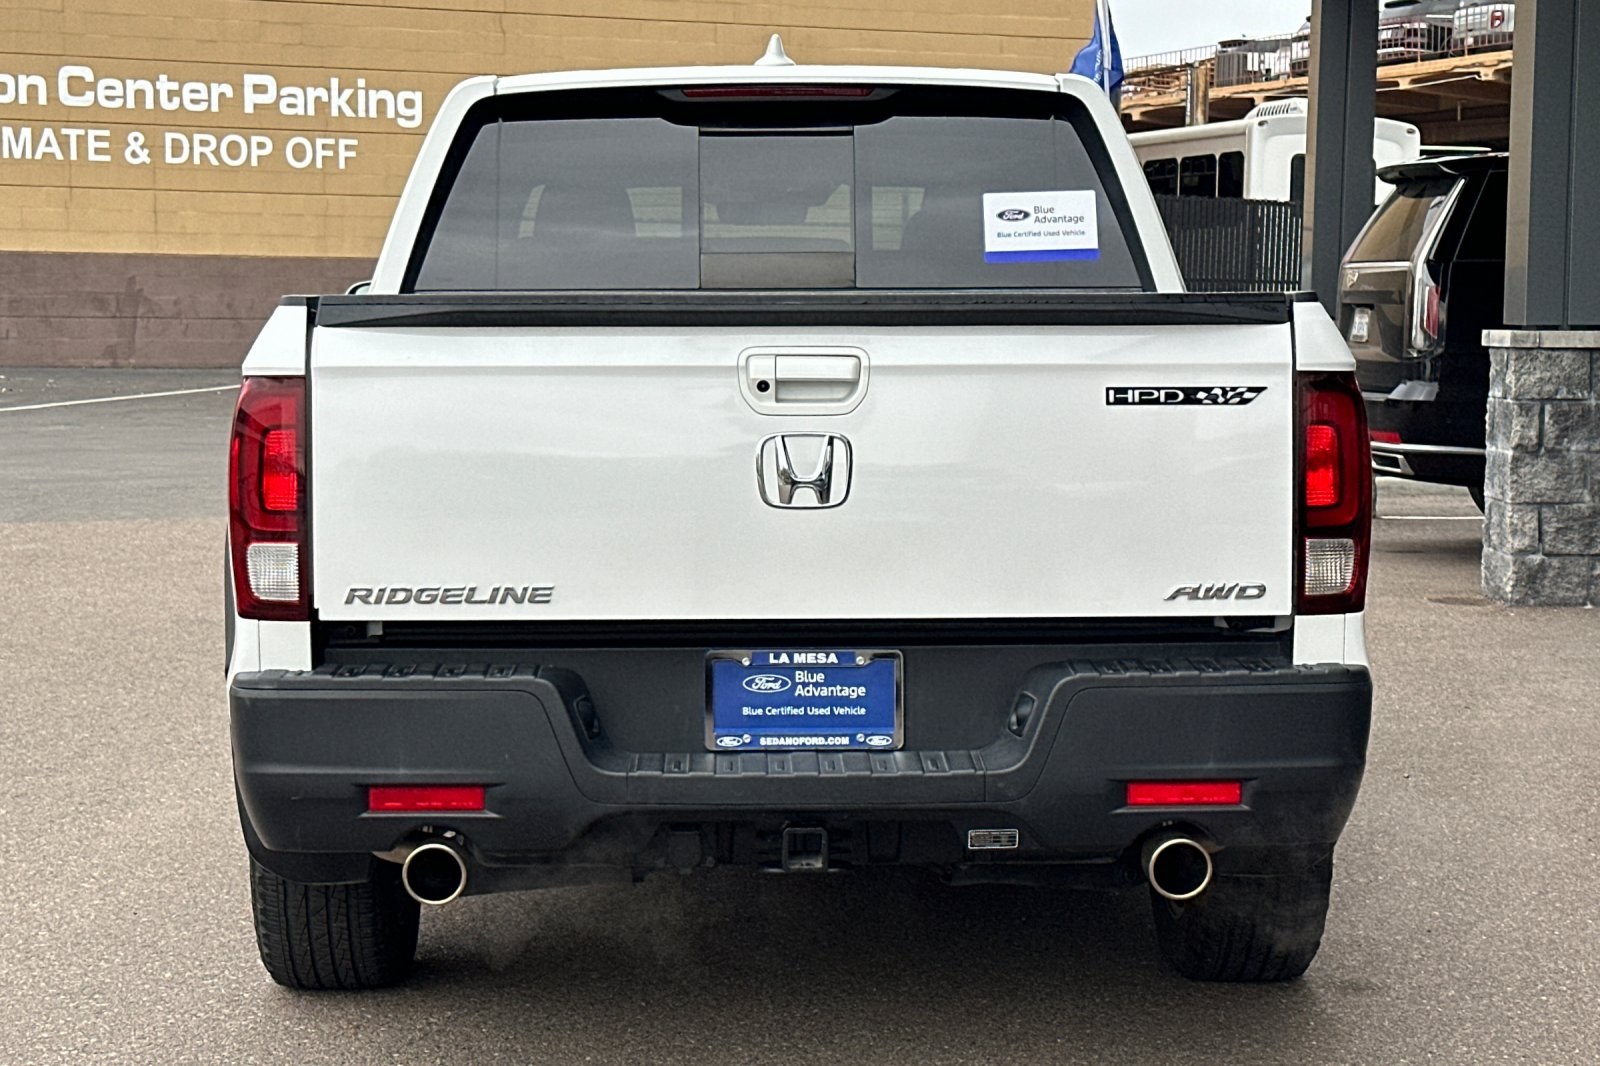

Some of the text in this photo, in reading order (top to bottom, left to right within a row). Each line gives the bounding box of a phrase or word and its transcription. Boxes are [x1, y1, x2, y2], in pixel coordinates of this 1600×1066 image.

[0, 65, 423, 128] on Center Parking
[2, 126, 359, 170] MATE & DROP OFF
[1033, 206, 1055, 214] Blue
[1033, 215, 1085, 225] Advantage
[1013, 230, 1041, 238] Certified
[1108, 389, 1185, 403] HPD
[344, 585, 555, 605] RIDGELINE
[1163, 582, 1267, 601] AWD
[769, 652, 839, 664] LA MESA
[751, 676, 783, 690] Ford
[795, 670, 825, 683] Blue
[794, 684, 866, 698] Advantage
[742, 706, 867, 715] Blue Certified Used Vehicle
[759, 736, 850, 746] SEDANOFORD.COM
